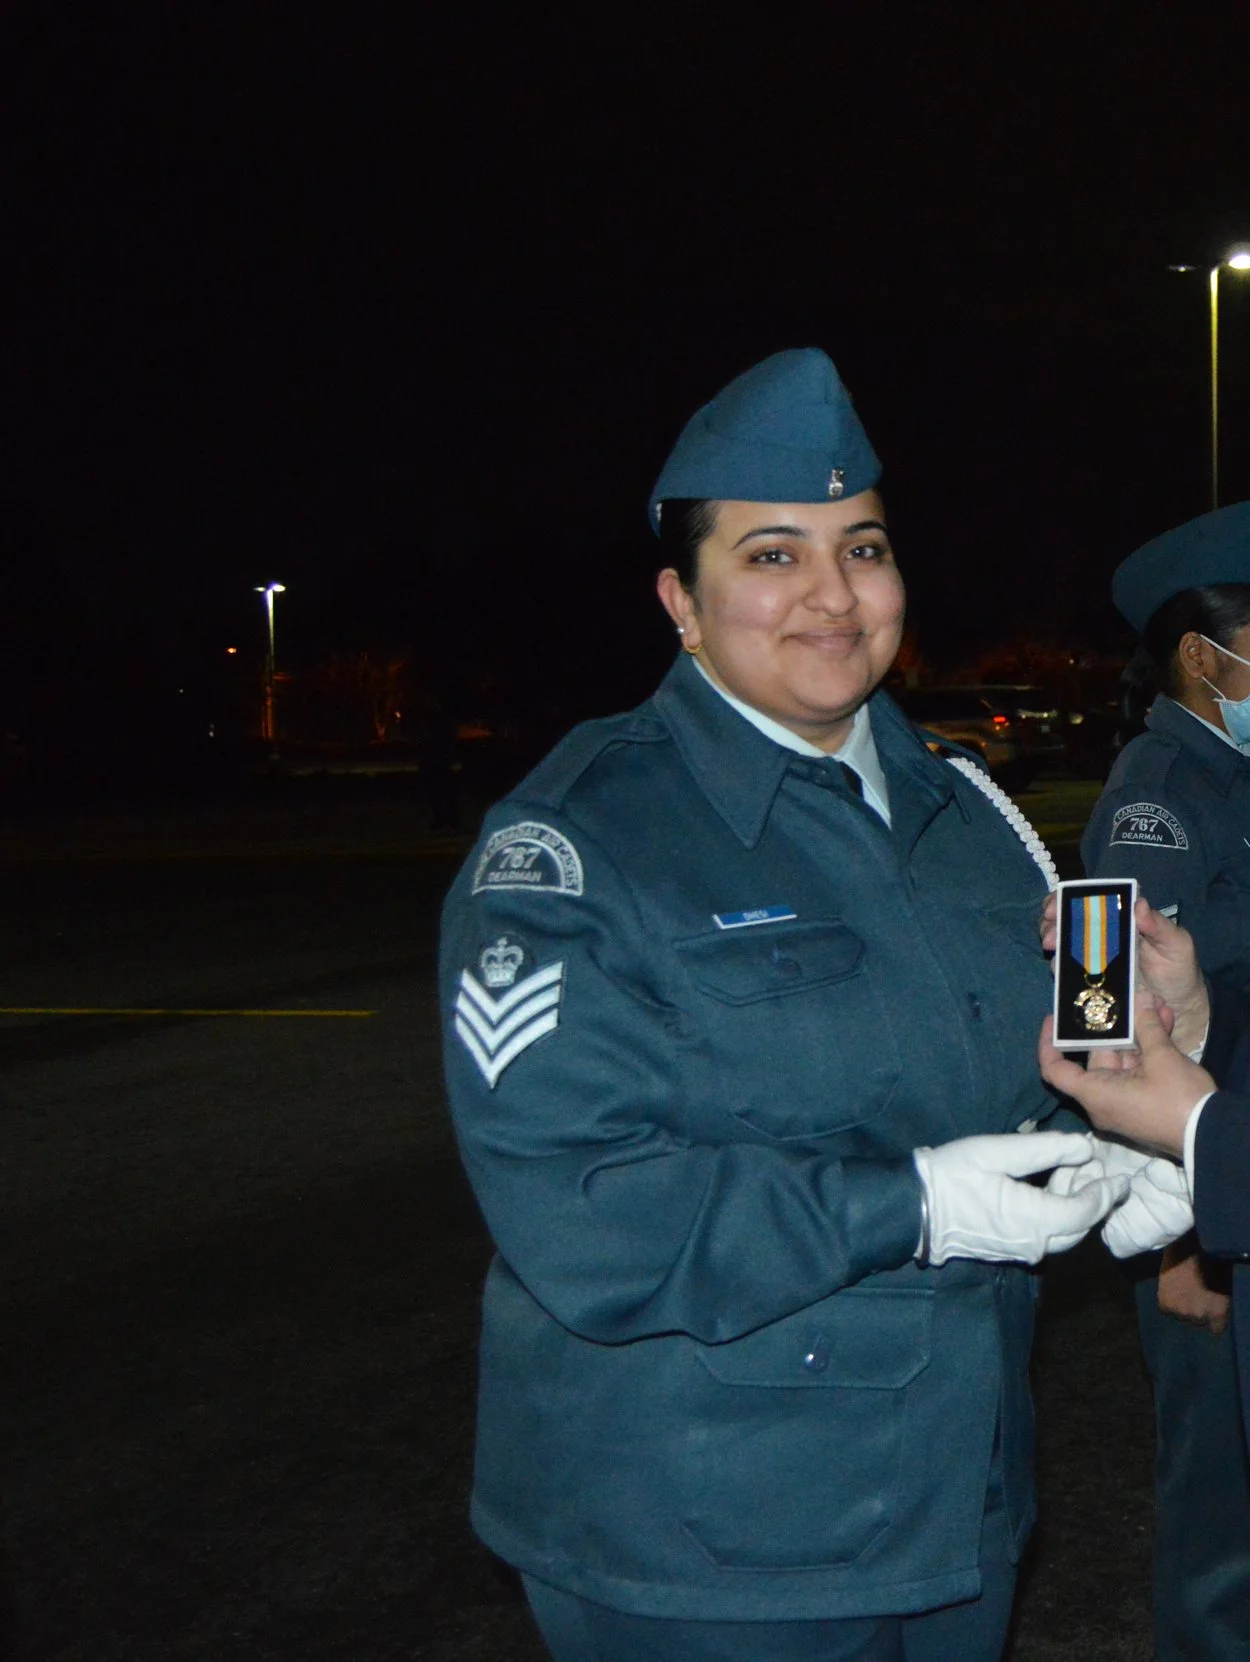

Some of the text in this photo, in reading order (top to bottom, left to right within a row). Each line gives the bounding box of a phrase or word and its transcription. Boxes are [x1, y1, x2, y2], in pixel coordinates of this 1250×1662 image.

[1118, 805, 1186, 846] CANADIAN AIR CADETS
[1130, 818, 1158, 832] 767
[1122, 832, 1163, 842] DEARMAN
[500, 847, 542, 869] 767
[488, 871, 542, 883] DEARMAN
